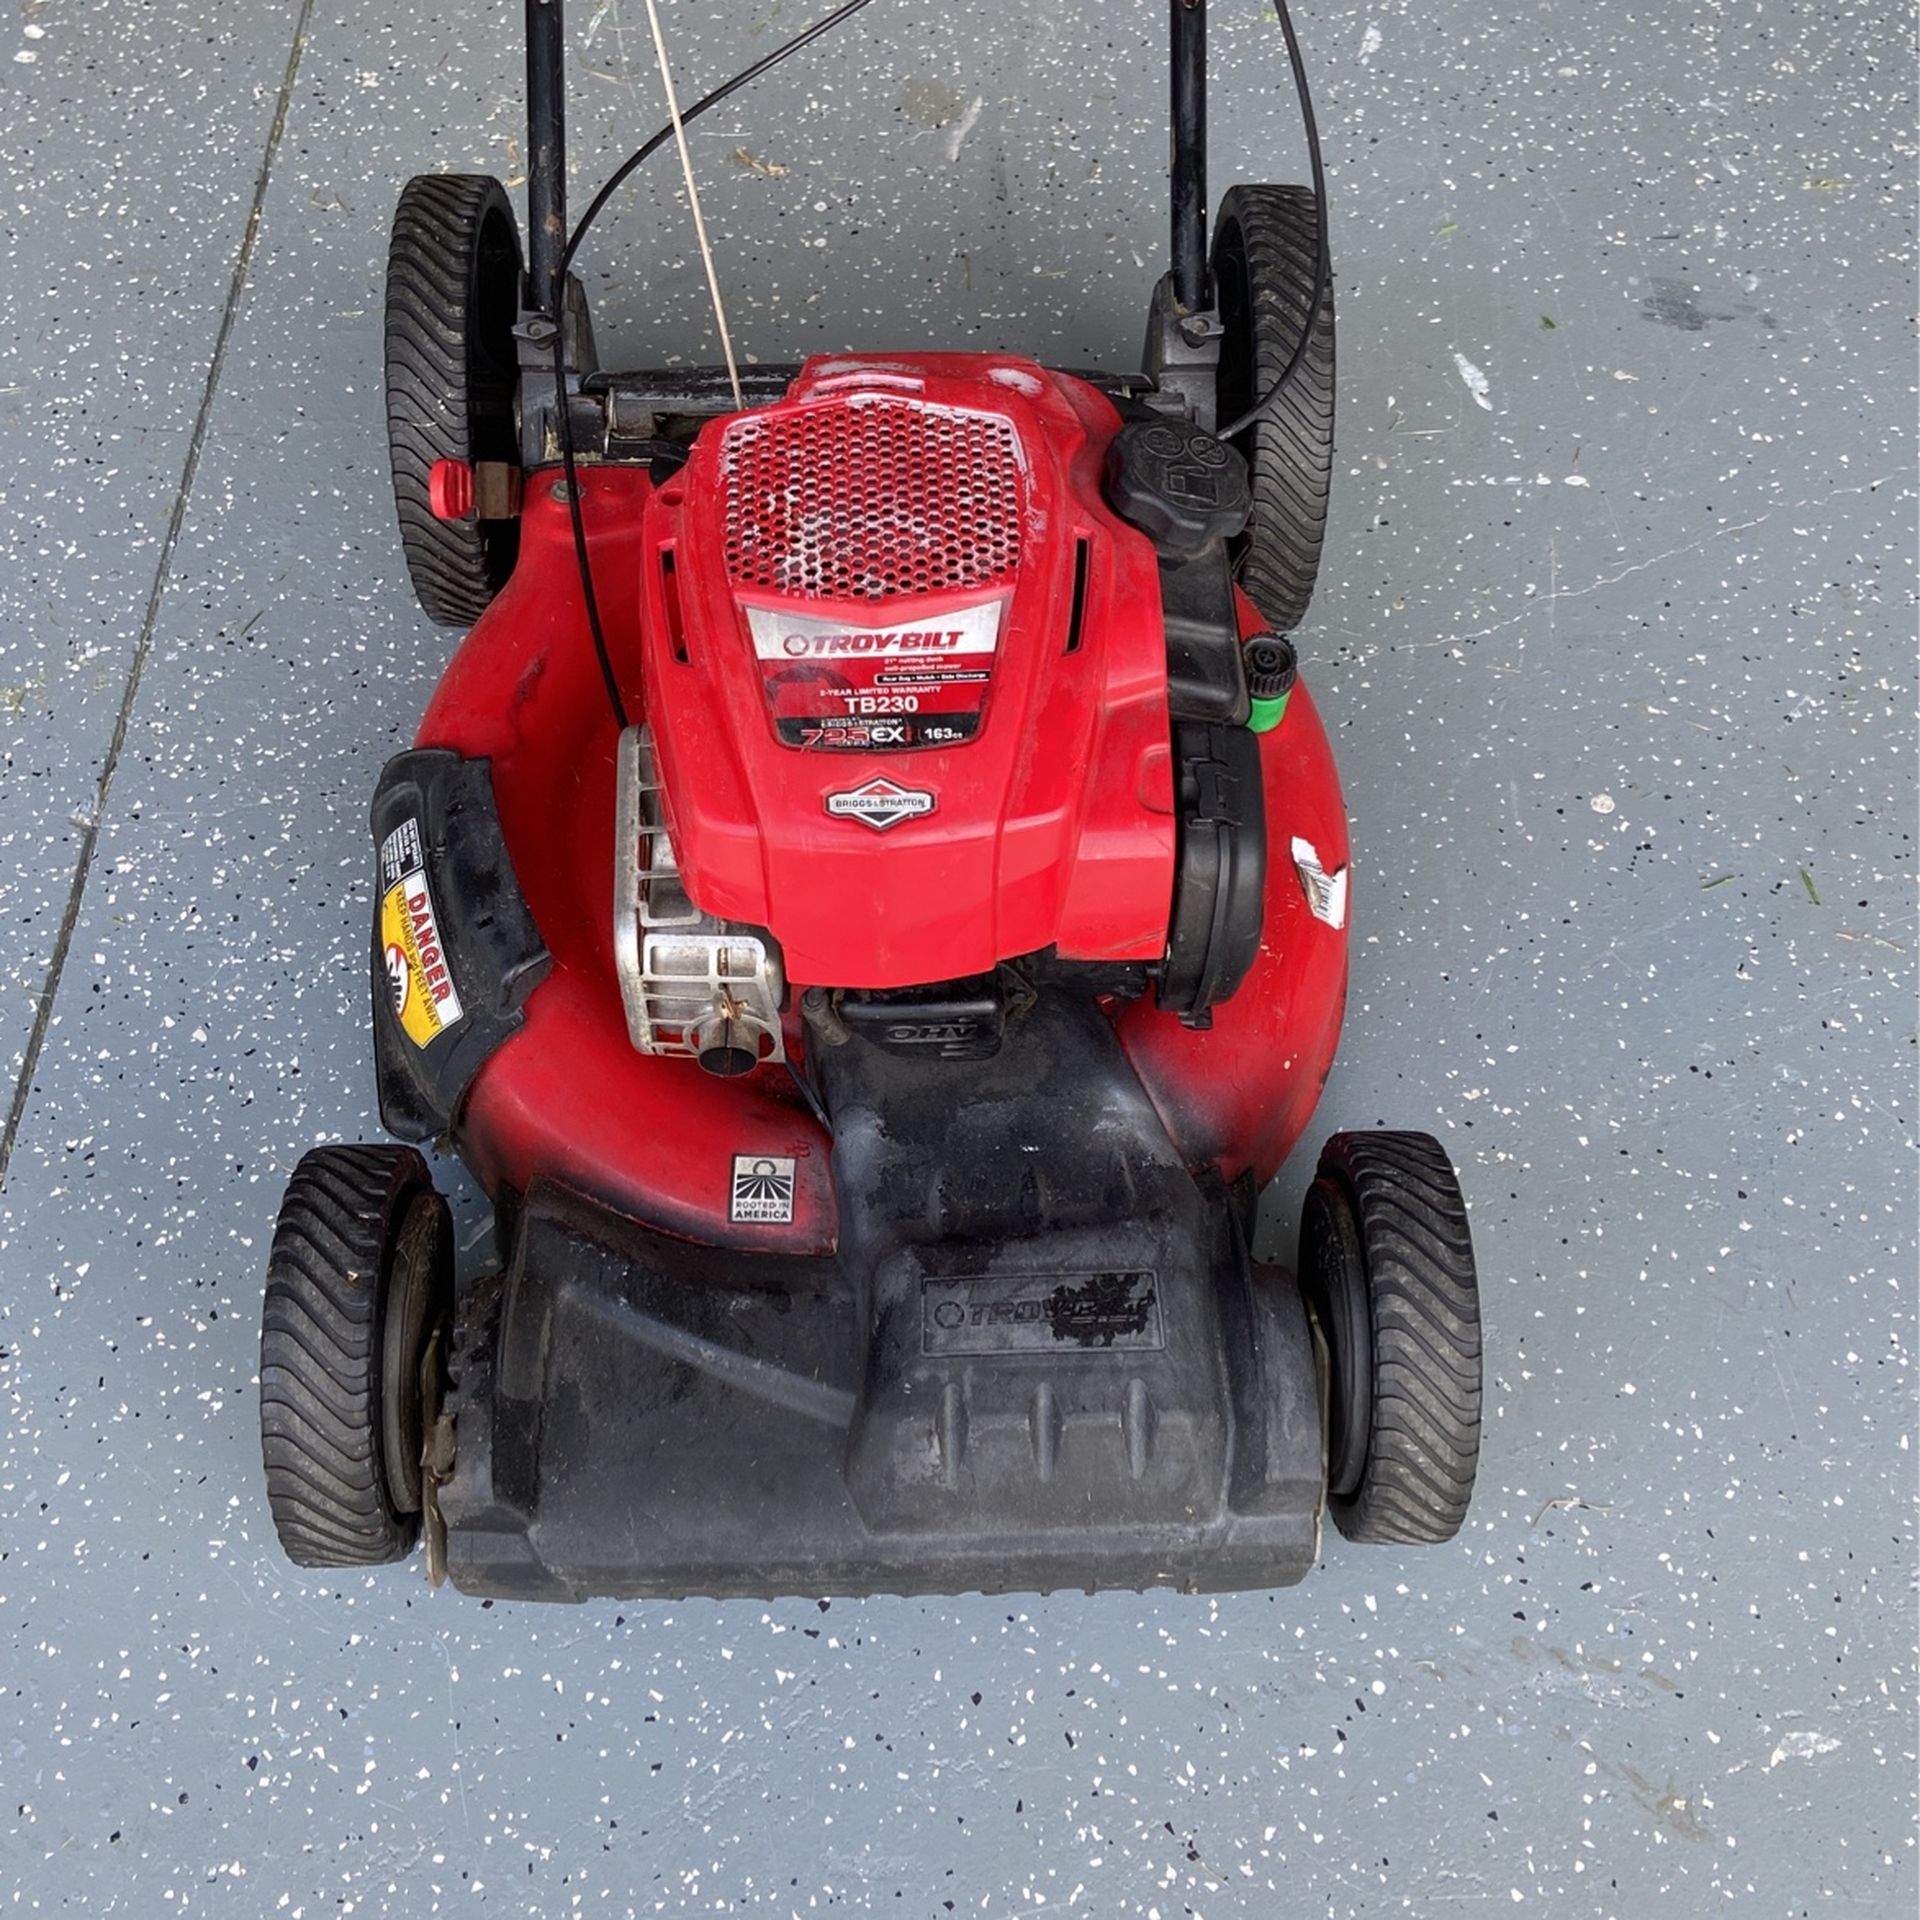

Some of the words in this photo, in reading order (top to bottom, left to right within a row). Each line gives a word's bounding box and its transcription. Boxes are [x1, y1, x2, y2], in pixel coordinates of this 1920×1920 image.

[812, 632, 964, 654] TROY-BILT
[854, 687, 889, 695] LIMITED
[891, 686, 941, 694] WARRANTY
[844, 696, 918, 713] TB230
[396, 891, 407, 915] KEEP
[400, 917, 417, 951] HANDS
[408, 892, 450, 1005] DANGER
[414, 970, 429, 996] FEET
[423, 998, 440, 1027] AWAY
[735, 1210, 789, 1219] AMERICA
[736, 1201, 776, 1209] ROOTED
